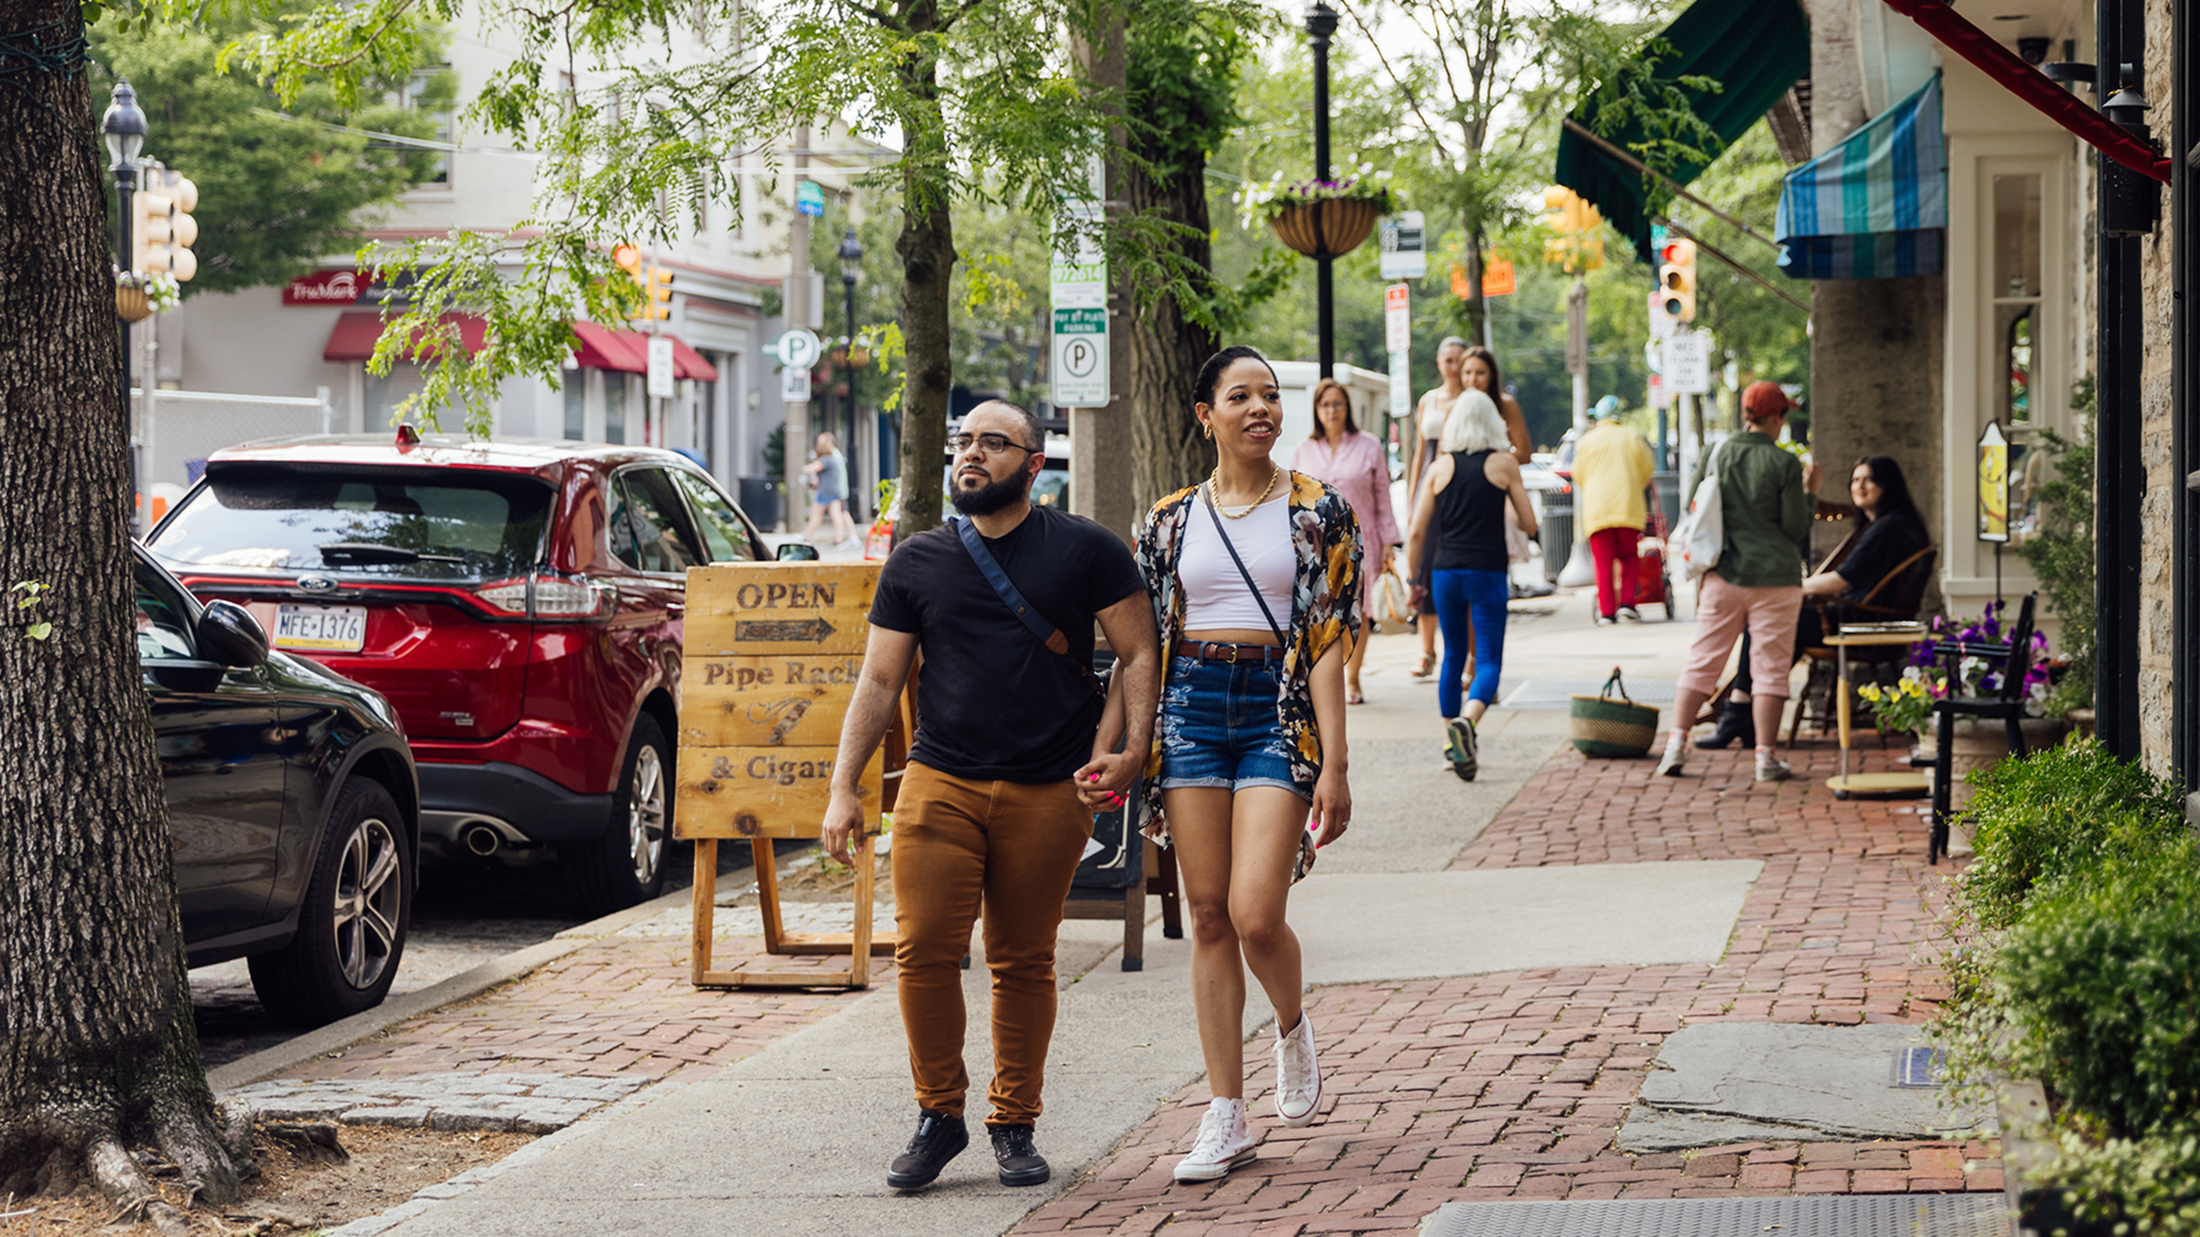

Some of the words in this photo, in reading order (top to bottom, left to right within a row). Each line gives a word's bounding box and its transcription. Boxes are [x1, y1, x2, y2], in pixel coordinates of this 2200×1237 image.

[1063, 323, 1097, 333] PARKING
[1074, 344, 1086, 369] P
[736, 582, 838, 609] OPEN
[704, 662, 774, 691] Pipe
[711, 755, 736, 780] &
[746, 754, 836, 786] Cigar
